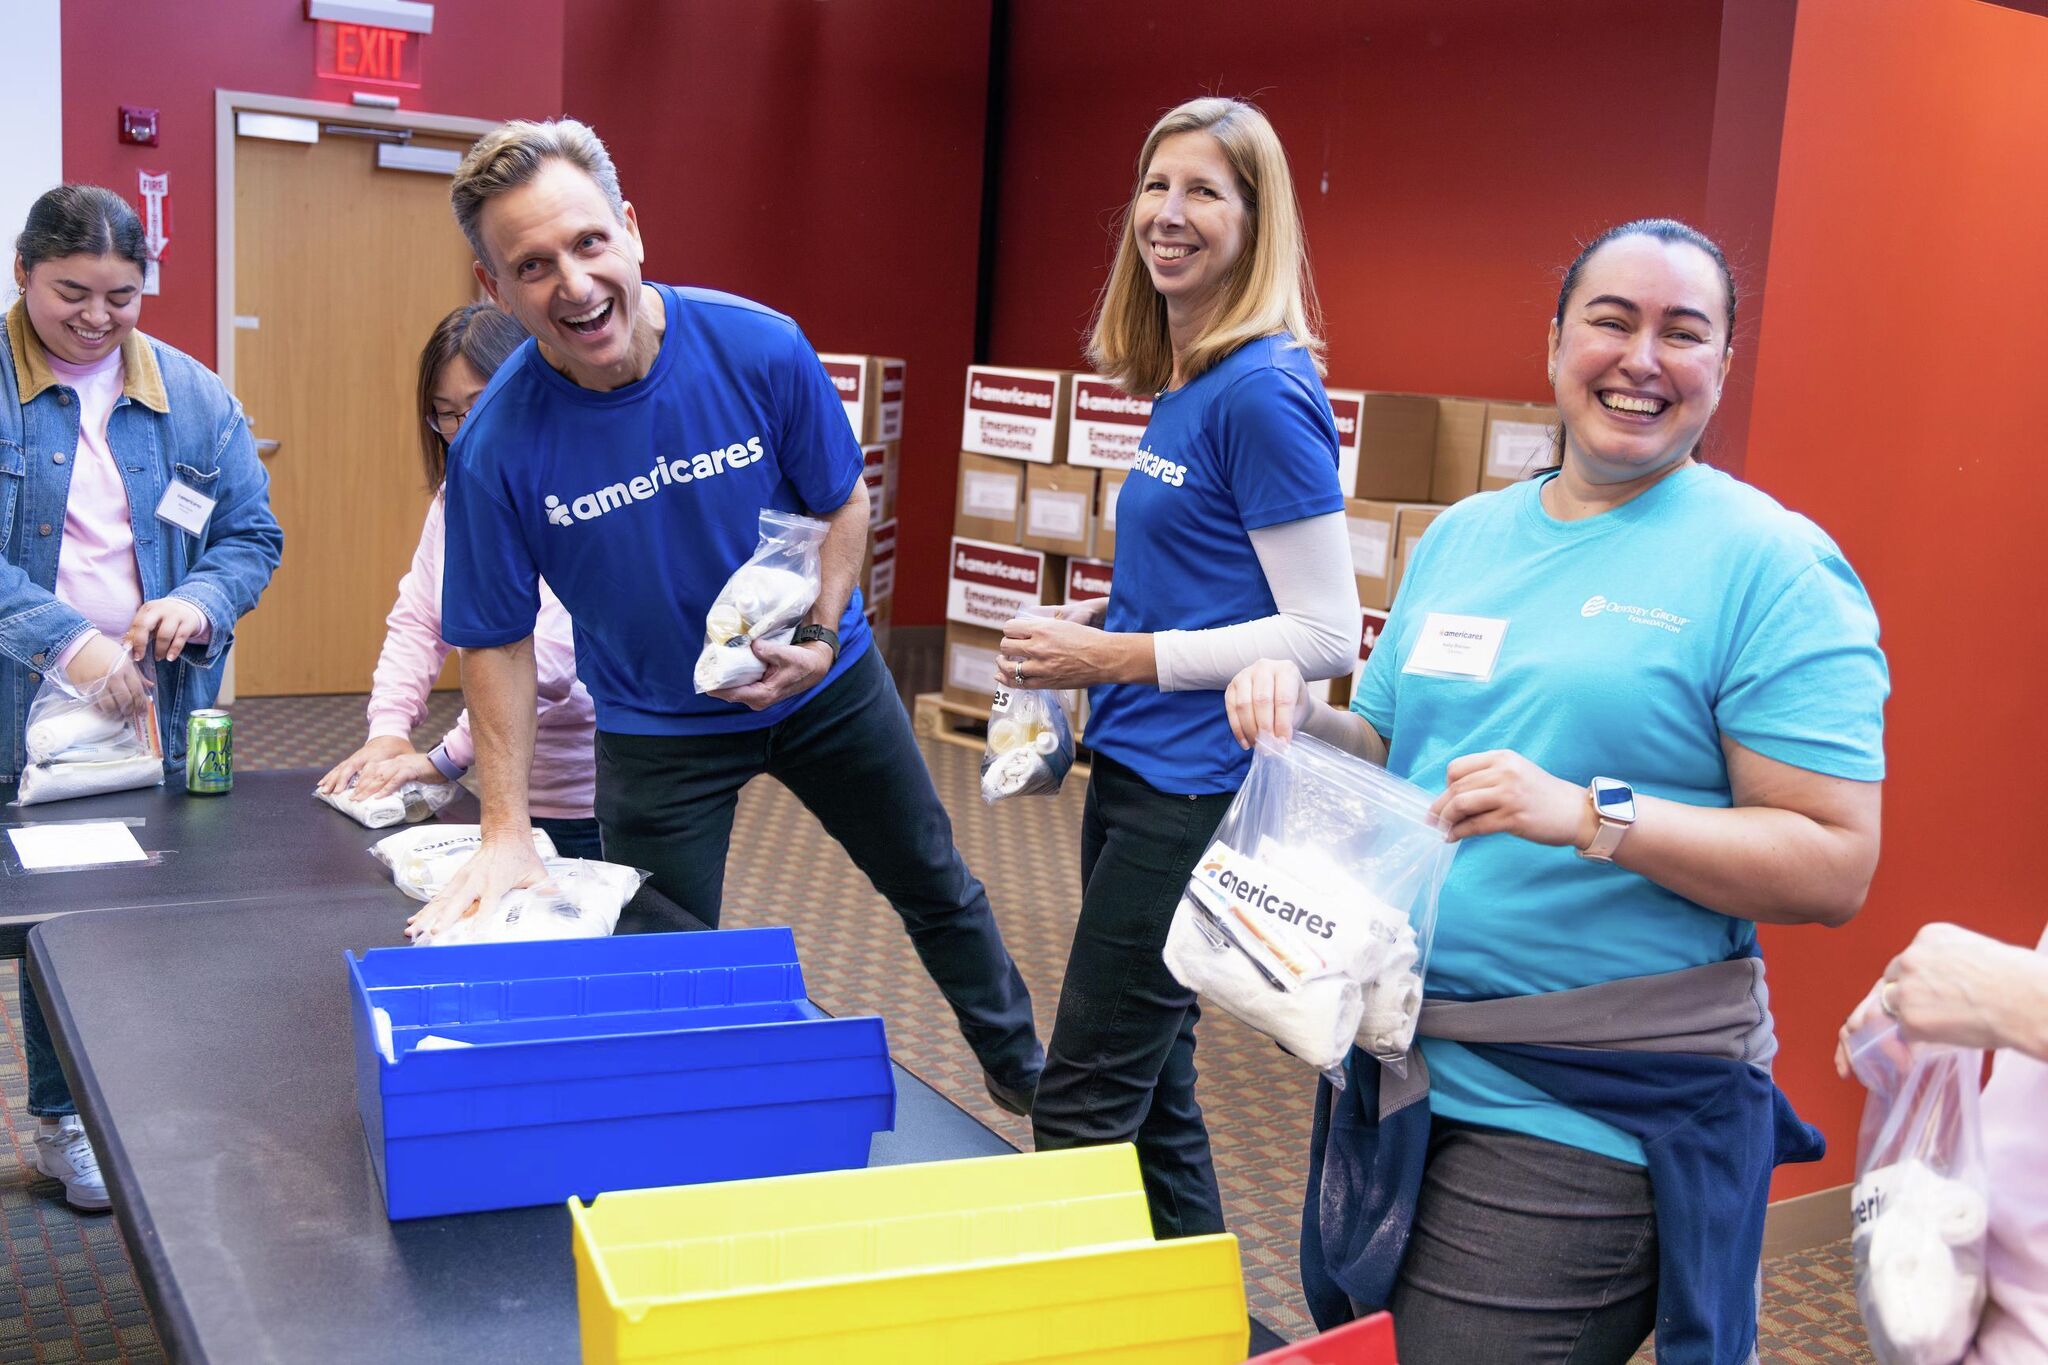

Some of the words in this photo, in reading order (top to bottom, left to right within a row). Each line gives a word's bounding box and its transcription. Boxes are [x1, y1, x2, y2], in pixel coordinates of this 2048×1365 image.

[336, 23, 407, 80] EXIT
[982, 386, 1051, 408] americares
[1089, 395, 1153, 416] america
[980, 416, 1036, 437] Emergency
[1089, 427, 1141, 445] Emergen
[981, 432, 1032, 451] Response
[1091, 444, 1136, 461] Respon
[1133, 445, 1188, 487] ericares
[572, 436, 764, 521] americares
[965, 558, 1036, 583] americares
[413, 837, 482, 853] ricares
